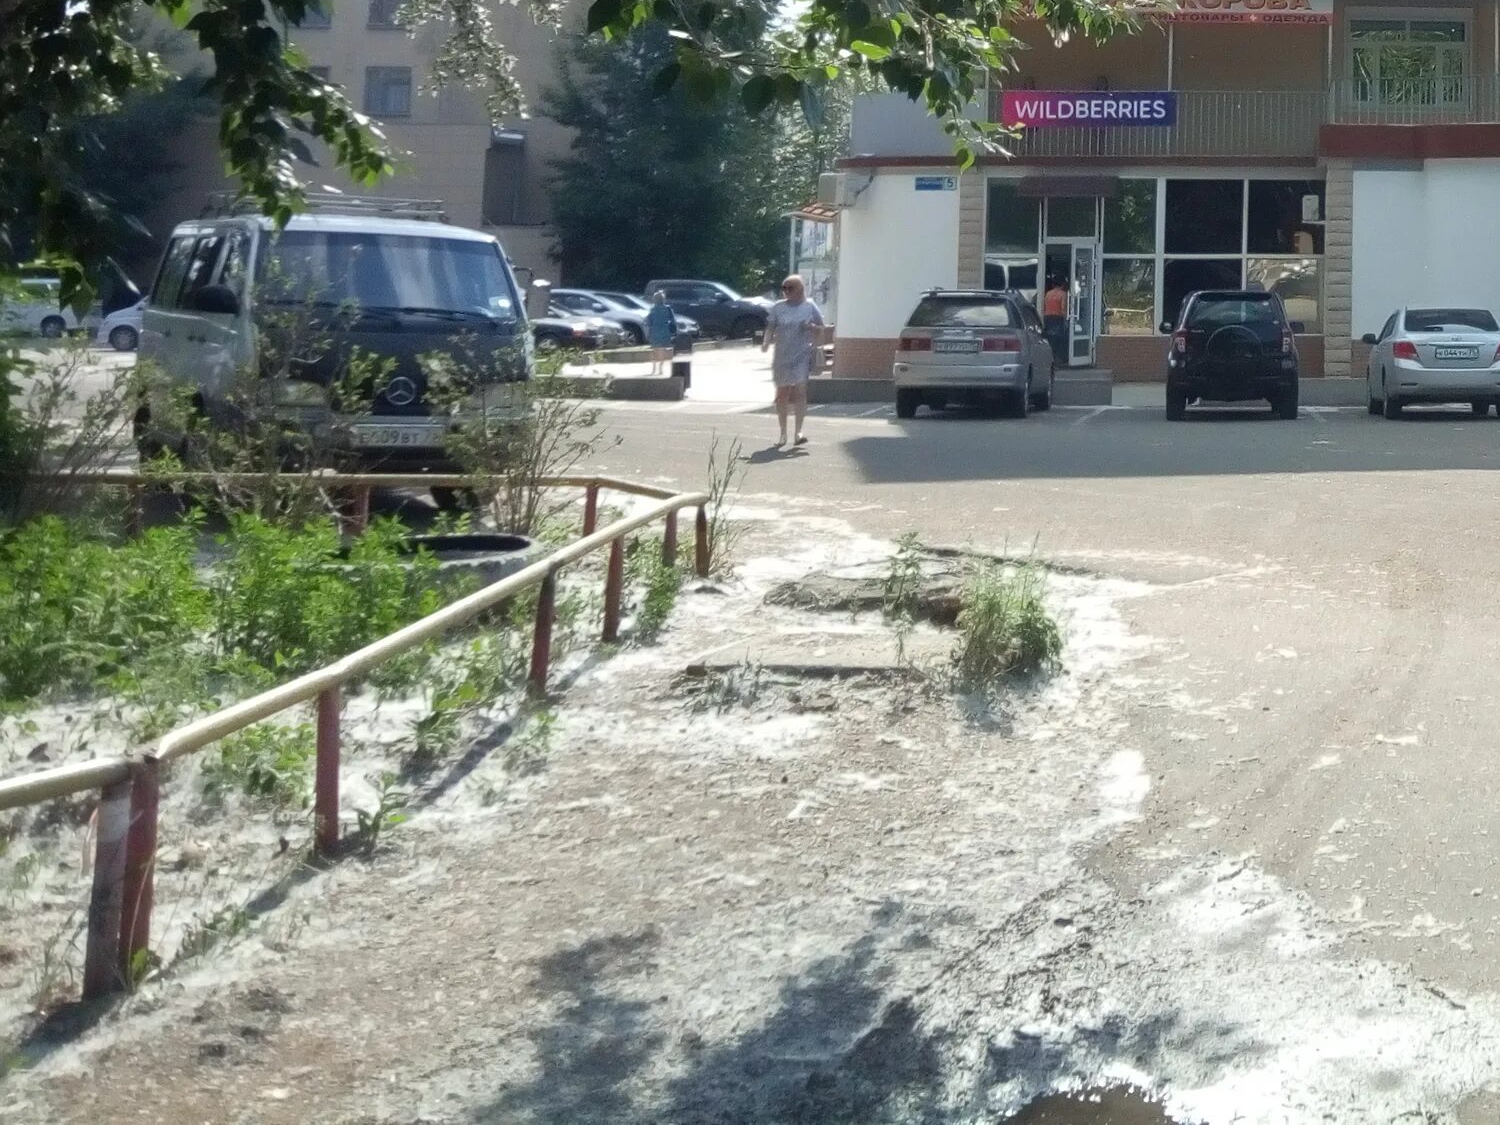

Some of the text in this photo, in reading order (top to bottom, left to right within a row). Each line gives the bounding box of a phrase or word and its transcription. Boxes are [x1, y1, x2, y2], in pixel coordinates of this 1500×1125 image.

[1263, 14, 1329, 24] ОДЕЖДА
[1014, 99, 1166, 119] WILDBERRIES
[947, 178, 954, 188] 5
